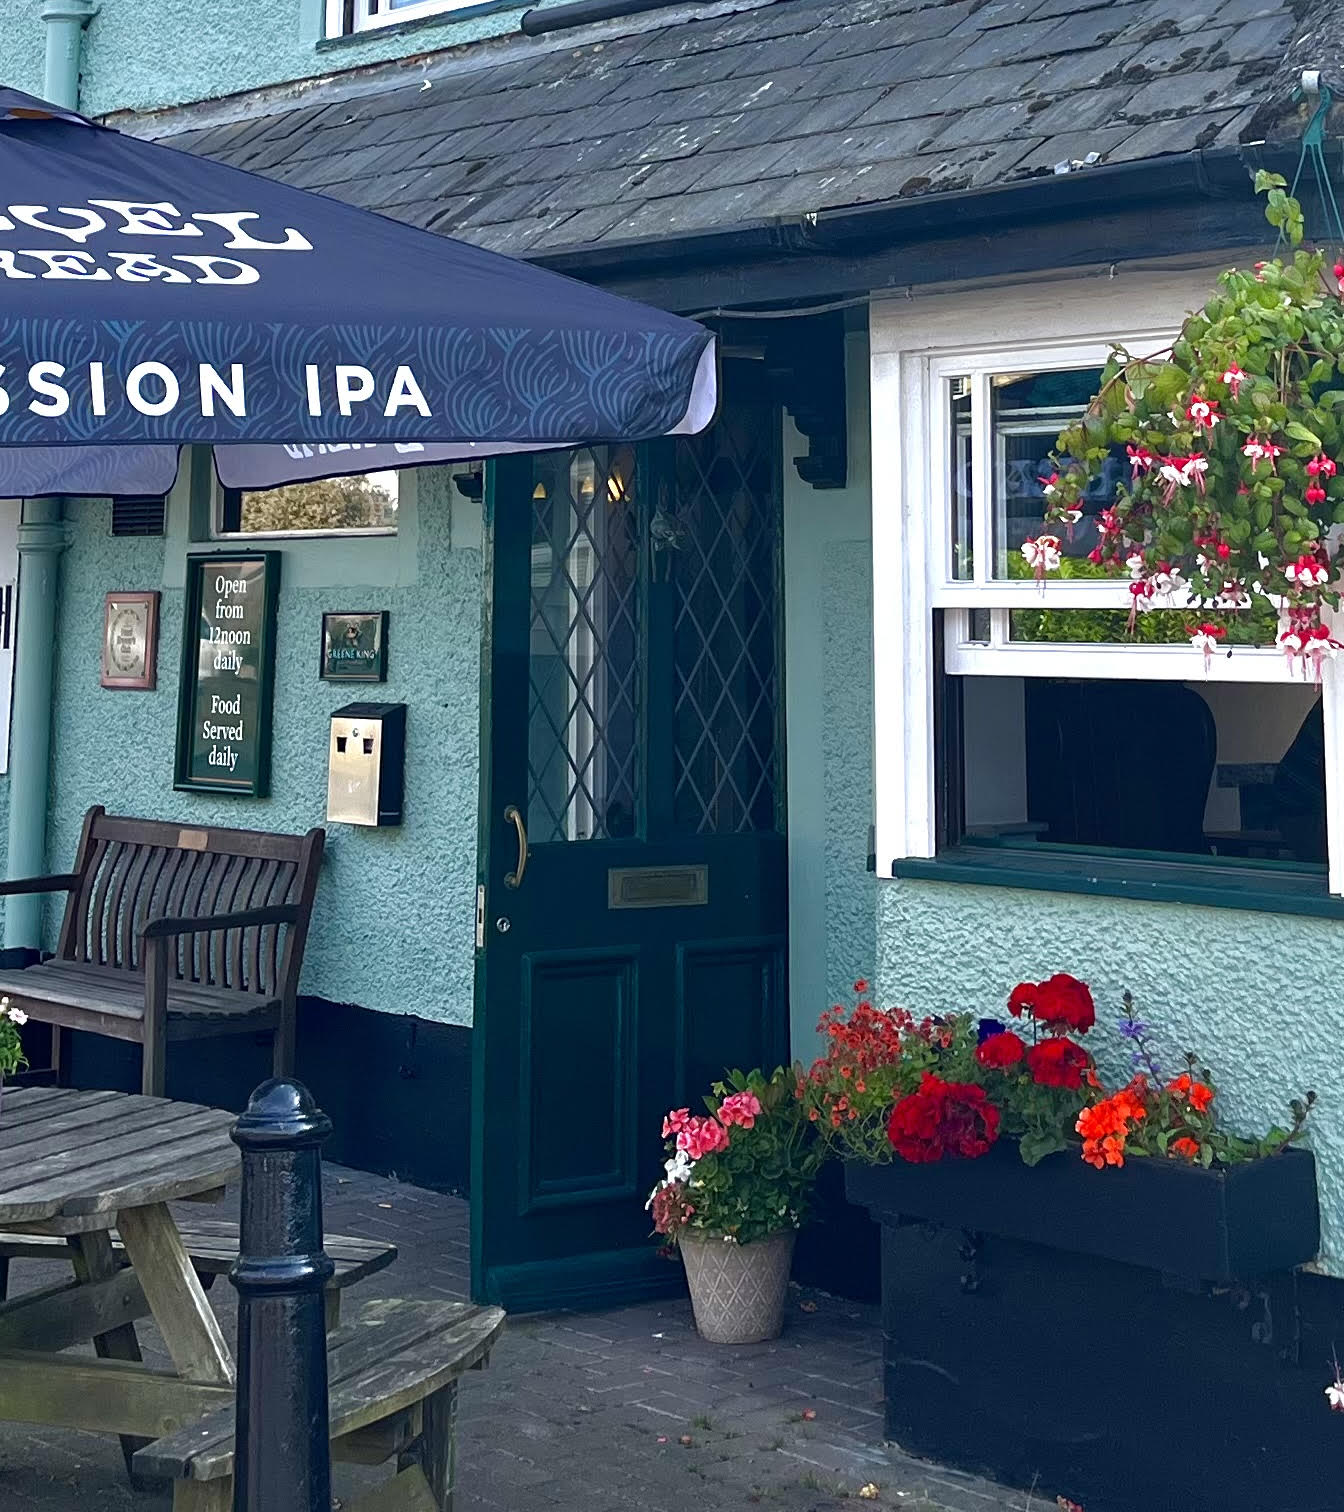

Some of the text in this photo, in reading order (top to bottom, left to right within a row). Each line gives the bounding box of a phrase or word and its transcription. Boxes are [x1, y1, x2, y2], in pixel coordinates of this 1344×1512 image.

[306, 364, 433, 418] IPA
[215, 575, 247, 599] Open
[215, 598, 244, 619] from
[209, 626, 251, 645] 12noon
[213, 650, 243, 675] daily
[327, 649, 375, 659] GREENE KING
[211, 694, 241, 715] Food
[202, 719, 244, 741] Served
[208, 744, 239, 772] daily
